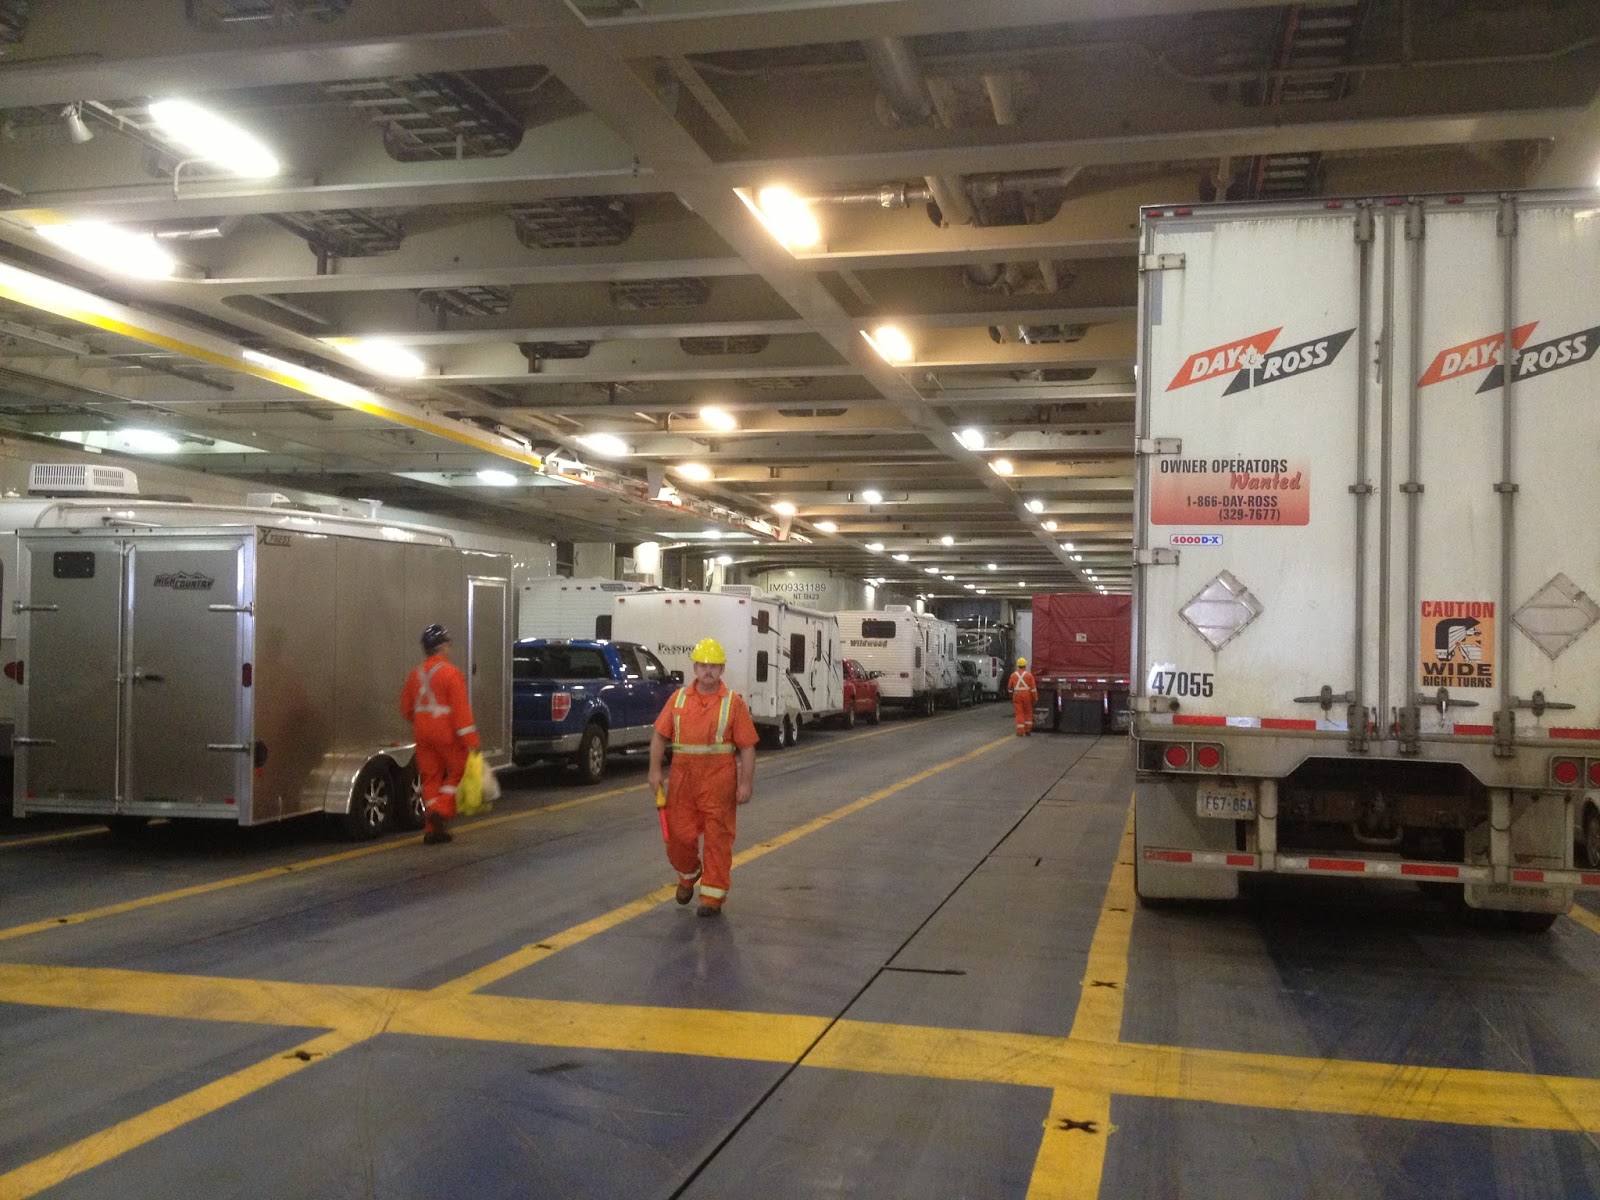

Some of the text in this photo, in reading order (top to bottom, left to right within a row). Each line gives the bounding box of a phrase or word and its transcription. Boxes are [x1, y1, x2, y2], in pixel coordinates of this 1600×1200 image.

[1190, 345, 1244, 380] DAY
[1263, 341, 1328, 380] ROSS
[1440, 335, 1587, 377] DAY ROSS
[1160, 459, 1288, 473] OWNER OPERATORS
[1230, 471, 1302, 490] Wanted
[1186, 495, 1278, 507] 1-866-DAY-ROSS
[1219, 508, 1281, 521] (329-7677)
[1422, 601, 1495, 618] CAUTION
[658, 643, 696, 653] Passpo
[850, 640, 888, 648] Wildwood
[1423, 662, 1492, 676] WIDE
[1152, 671, 1214, 697] 47055
[1423, 676, 1492, 688] RIGHT TURNS
